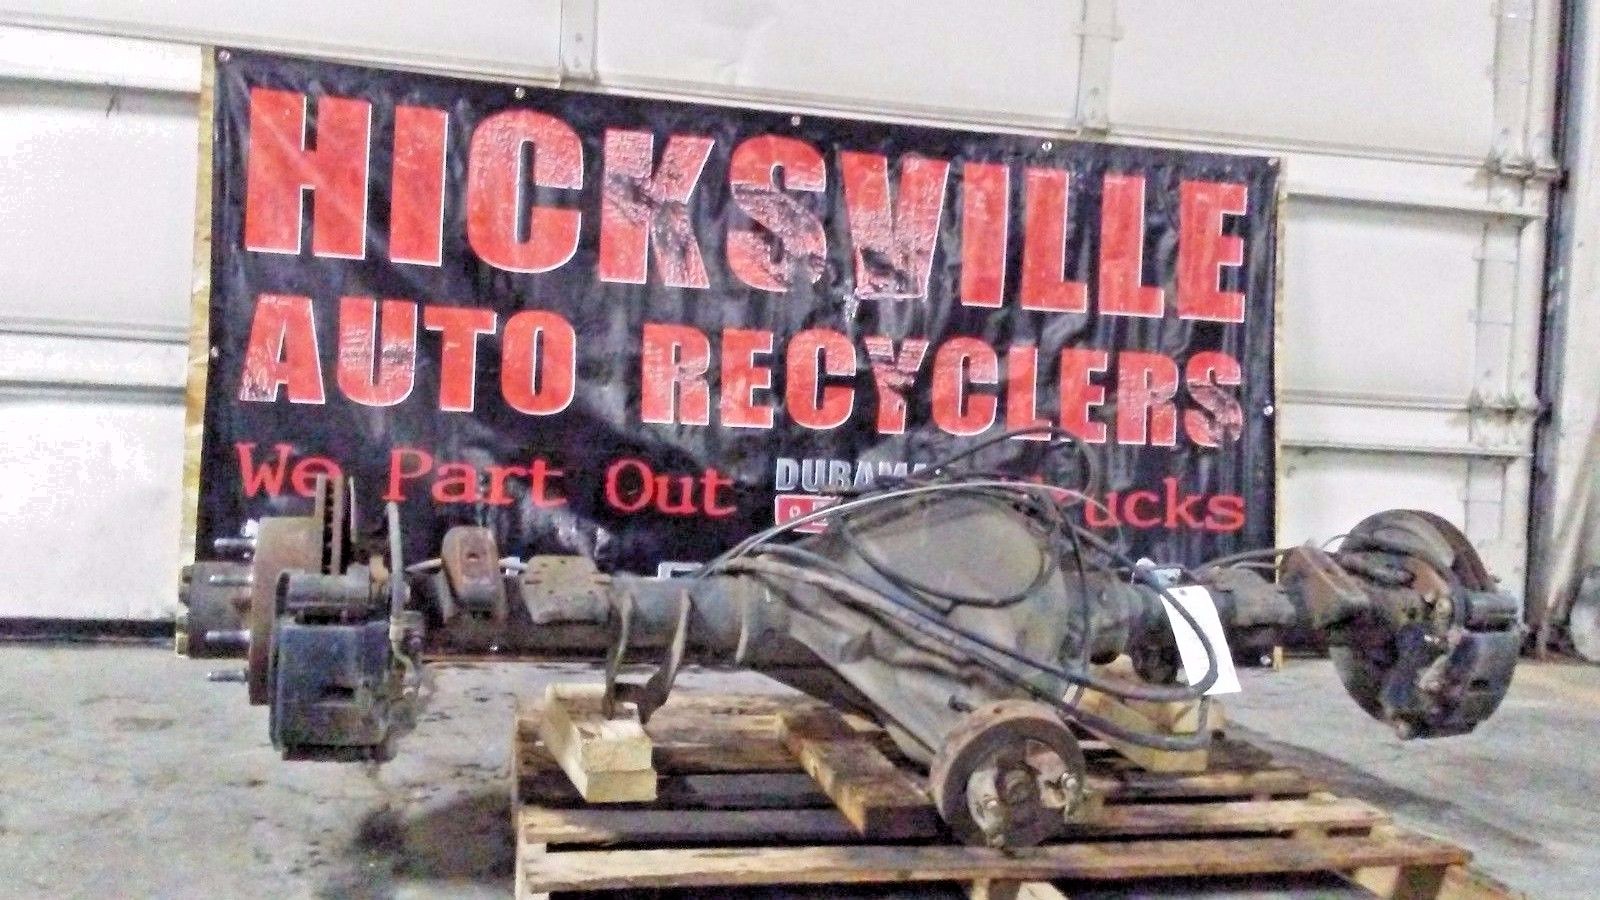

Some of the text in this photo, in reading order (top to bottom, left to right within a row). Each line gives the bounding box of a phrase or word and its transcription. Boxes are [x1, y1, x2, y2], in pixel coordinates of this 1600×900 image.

[243, 86, 1248, 324] HICKSVILLE
[239, 293, 1245, 448] AUTO RECYCLERS
[235, 442, 343, 498] We
[382, 442, 566, 508] Part
[606, 457, 738, 517] Out
[1002, 474, 1246, 533] ucks
